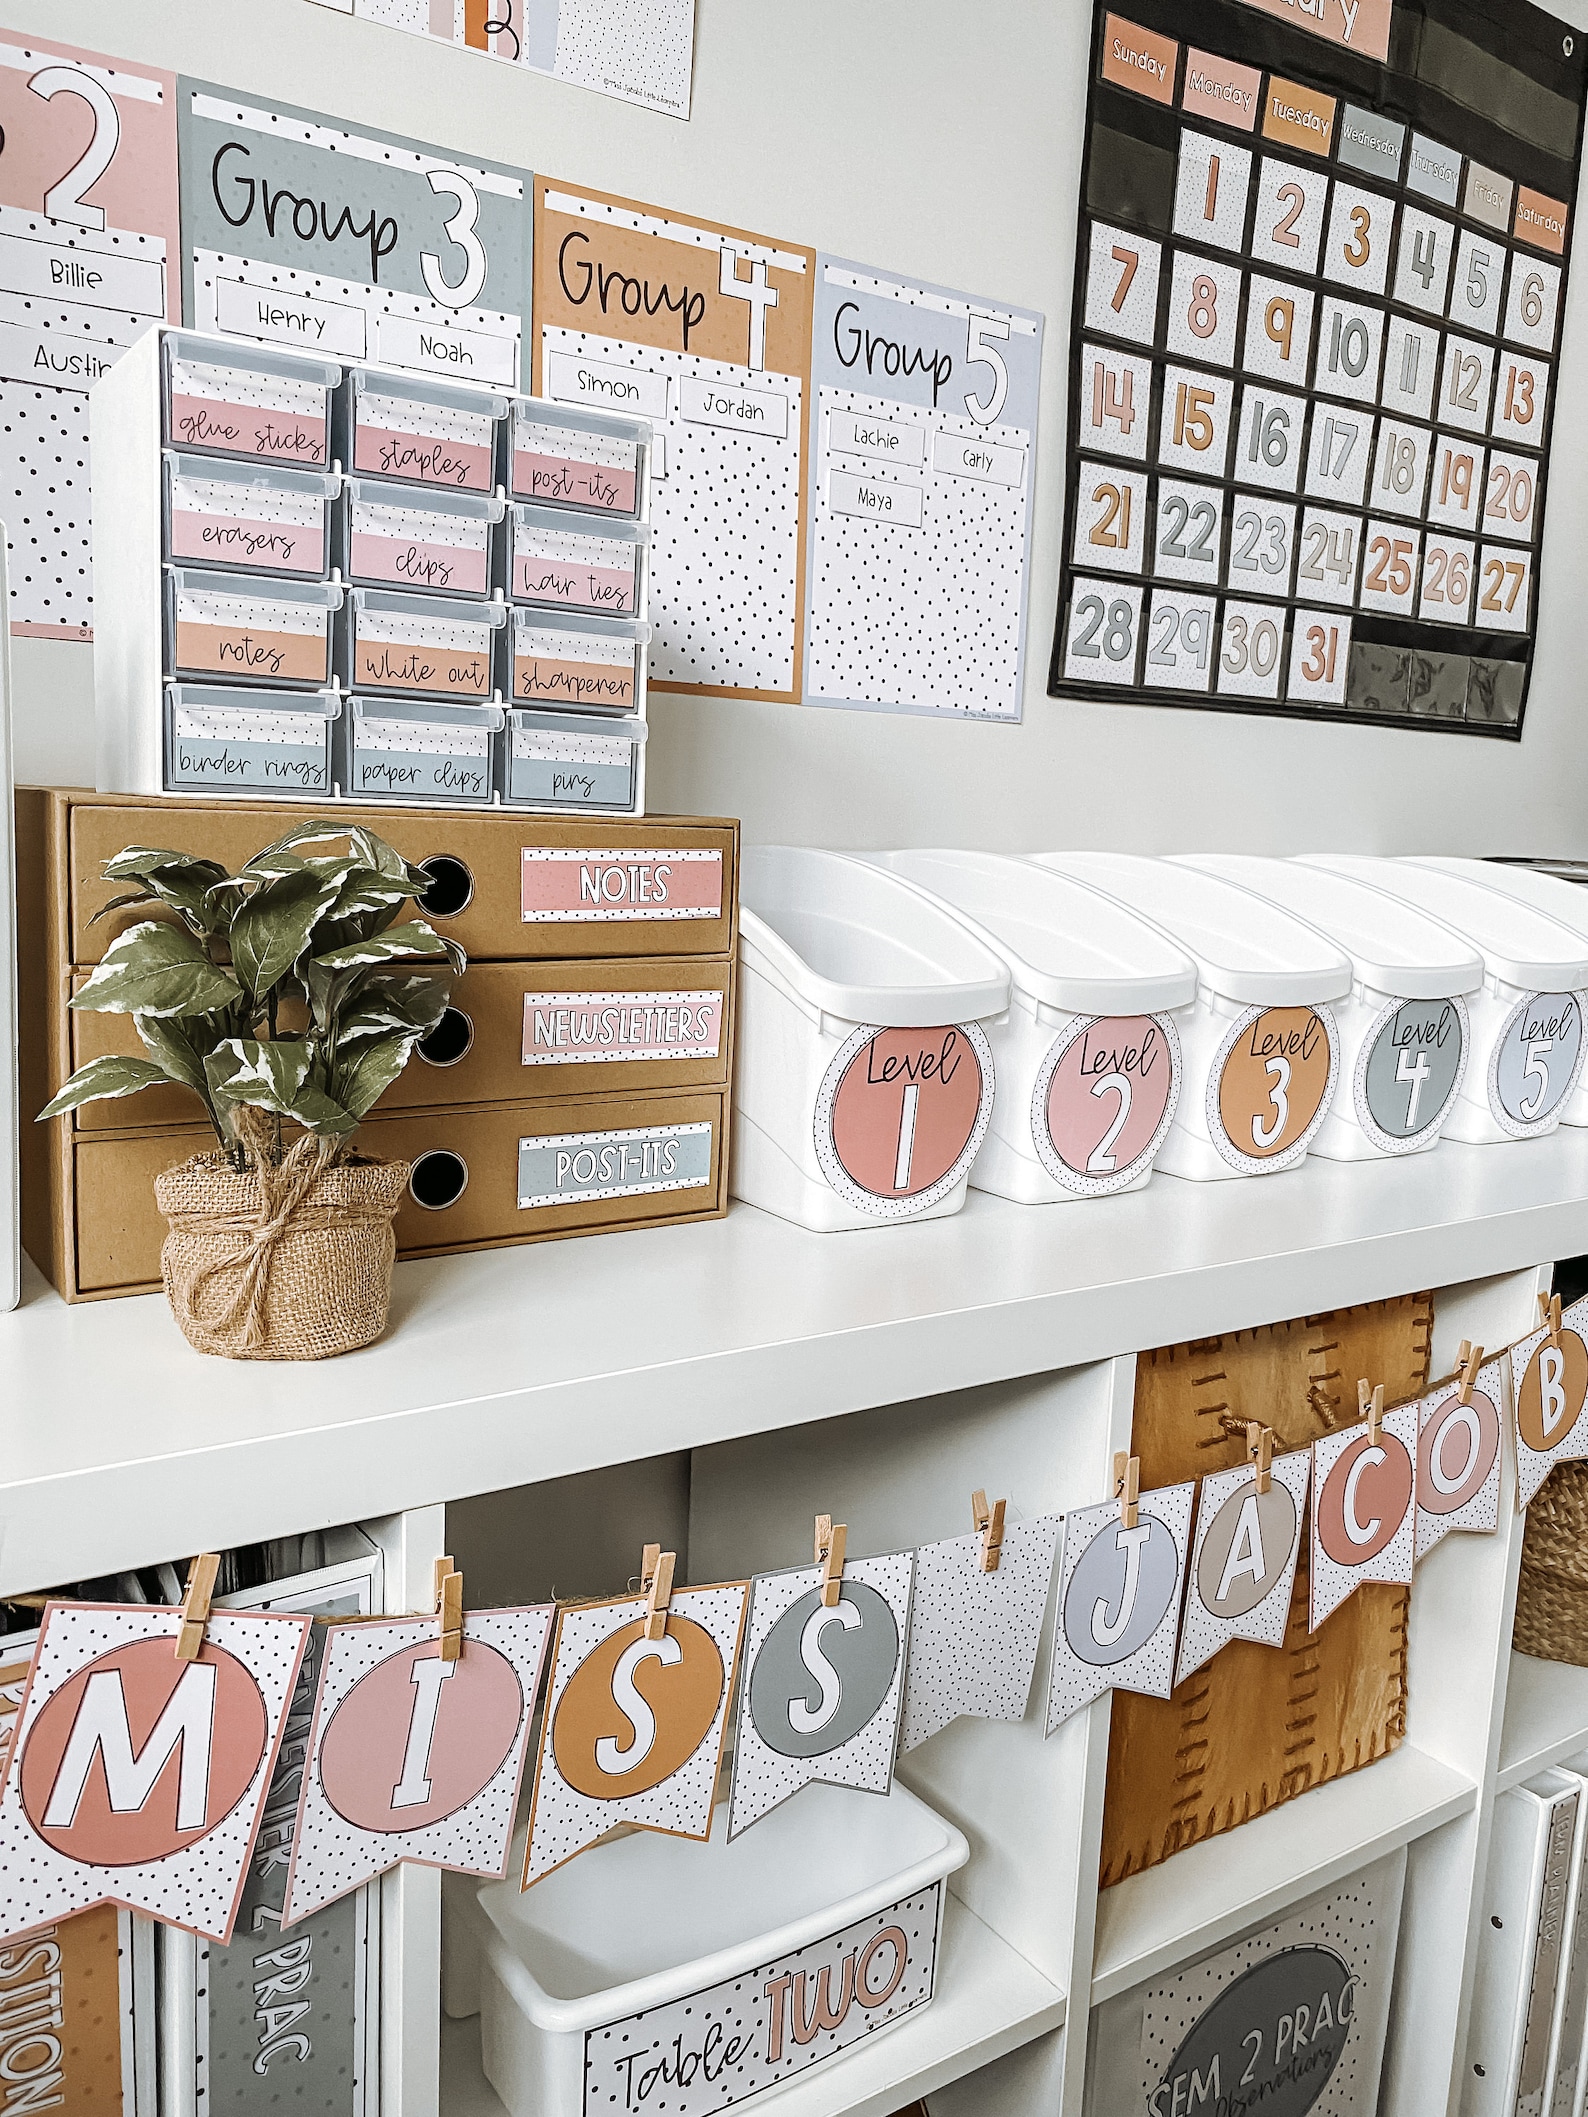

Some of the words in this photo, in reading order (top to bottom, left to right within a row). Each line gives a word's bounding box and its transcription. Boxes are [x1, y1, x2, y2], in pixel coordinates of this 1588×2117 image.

[27, 66, 120, 232] 2
[1112, 38, 1167, 83] Sunday
[1189, 70, 1252, 111] Monday
[1271, 97, 1330, 137] Tuesday
[1342, 122, 1400, 161] Wednesday
[1411, 150, 1458, 189] Thursday
[1472, 180, 1504, 209] Friday
[1517, 202, 1566, 238] Saturday
[212, 142, 398, 283] Group
[420, 169, 487, 308] 3
[1203, 154, 1220, 221] 1
[1272, 182, 1305, 248] 2
[1344, 205, 1371, 267] 3
[1411, 230, 1435, 290] 4
[1466, 248, 1489, 308] 5
[1520, 272, 1544, 326] 6
[50, 259, 103, 289] Billie
[258, 301, 326, 339] Henry
[559, 231, 705, 351] Group
[719, 246, 778, 372] 4
[420, 334, 473, 366] Noah
[1111, 245, 1138, 314] 7
[1187, 274, 1218, 339] 8
[1264, 296, 1294, 360] 9
[1328, 312, 1369, 377] 10
[1401, 333, 1421, 394] 11
[1449, 348, 1482, 412] 12
[1504, 366, 1535, 425] 13
[577, 370, 639, 400] Simon
[834, 302, 952, 408] Group
[964, 313, 1010, 426] 5
[703, 393, 764, 420] Jordan
[180, 409, 239, 443] glue
[255, 423, 325, 460] sticks
[854, 424, 899, 450] Lachie
[1092, 362, 1135, 434] 14
[1173, 383, 1214, 451] 15
[1249, 401, 1290, 467] 16
[1319, 416, 1358, 480] 17
[1381, 432, 1416, 494] 18
[1439, 449, 1473, 510] 19
[1485, 465, 1532, 522] 20
[378, 440, 470, 483] staples
[963, 449, 993, 473] Carly
[531, 467, 619, 507] post-its
[858, 487, 892, 511] Maya
[202, 526, 295, 559] erasers
[1088, 482, 1132, 549] 21
[1159, 495, 1217, 562] 22
[1232, 512, 1286, 575] 23
[1299, 522, 1353, 585] 24
[1364, 535, 1412, 596] 25
[1423, 547, 1470, 606] 26
[1480, 558, 1526, 613] 27
[396, 546, 454, 585] clips
[524, 567, 576, 593] hair
[588, 574, 629, 610] ties
[218, 637, 286, 672] notes
[1071, 595, 1133, 661] 28
[1148, 604, 1211, 669] 29
[1222, 615, 1278, 677] 30
[1301, 624, 1336, 683] 31
[448, 659, 485, 689] out
[520, 669, 631, 700] sharpener
[180, 747, 251, 775] binder
[264, 759, 326, 784] rings
[362, 763, 421, 791] paper
[433, 760, 484, 792] clips
[552, 771, 595, 798] pins
[579, 864, 672, 904] NOTES
[533, 1005, 714, 1048] NEWSLETTERS
[1250, 1014, 1320, 1061] Level
[1392, 1006, 1453, 1048] Level
[1520, 1002, 1574, 1042] Level
[867, 1030, 962, 1085] Level
[1079, 1028, 1158, 1077] Level
[1395, 1048, 1431, 1129] 4
[1519, 1038, 1554, 1120] 5
[1085, 1071, 1133, 1172] 2
[1251, 1055, 1292, 1149] 3
[893, 1083, 920, 1190] 1
[555, 1139, 681, 1188] POST-ITS
[252, 1933, 313, 2077] PRAC
[614, 2022, 754, 2109] Table
[764, 1925, 908, 2064] TWO
[1148, 2052, 1221, 2117] SEM
[1239, 2028, 1264, 2087] 2
[1275, 1975, 1360, 2065] PRAC
